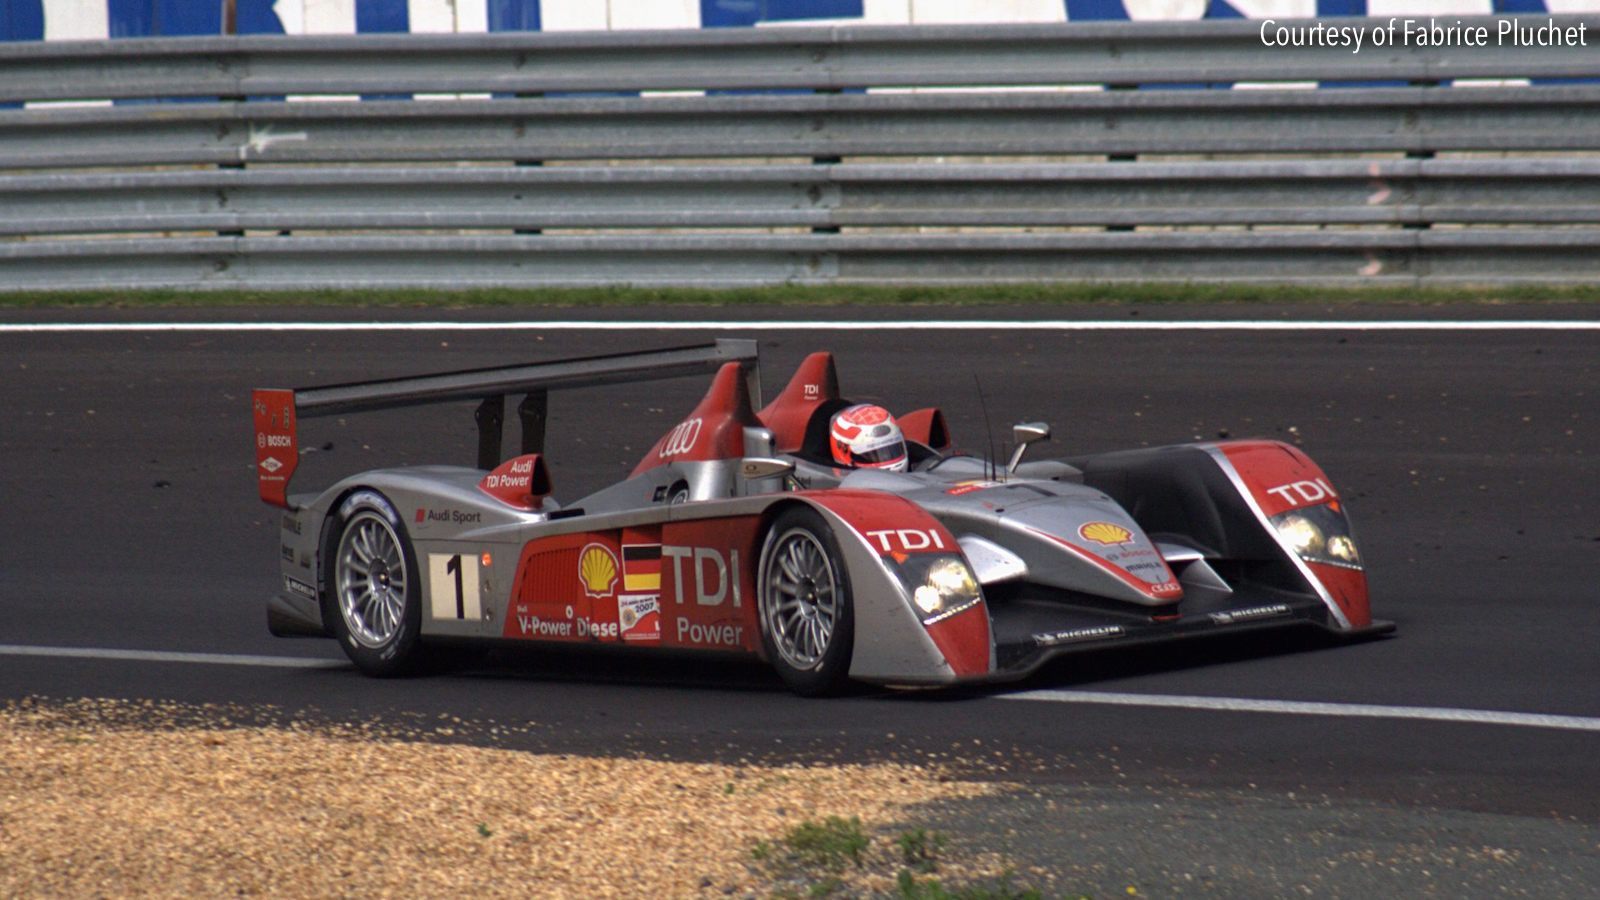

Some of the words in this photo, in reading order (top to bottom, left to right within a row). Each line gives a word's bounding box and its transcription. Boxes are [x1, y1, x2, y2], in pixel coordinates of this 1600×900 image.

[803, 384, 819, 394] TDI
[267, 435, 291, 447] BOSCH
[511, 460, 532, 473] Audi
[486, 475, 500, 488] TDI
[500, 474, 530, 487] Power
[1266, 477, 1336, 506] TDI
[427, 509, 450, 521] Audi
[452, 510, 481, 525] Sport
[865, 528, 945, 551] TDI
[661, 546, 742, 608] TDI
[446, 554, 465, 620] 1
[635, 602, 655, 613] 2007
[1231, 604, 1286, 617] MICHELIN
[517, 613, 573, 636] V-Power
[576, 616, 618, 637] Diese
[676, 617, 743, 645] Power
[1056, 626, 1119, 639] MICHELIN
